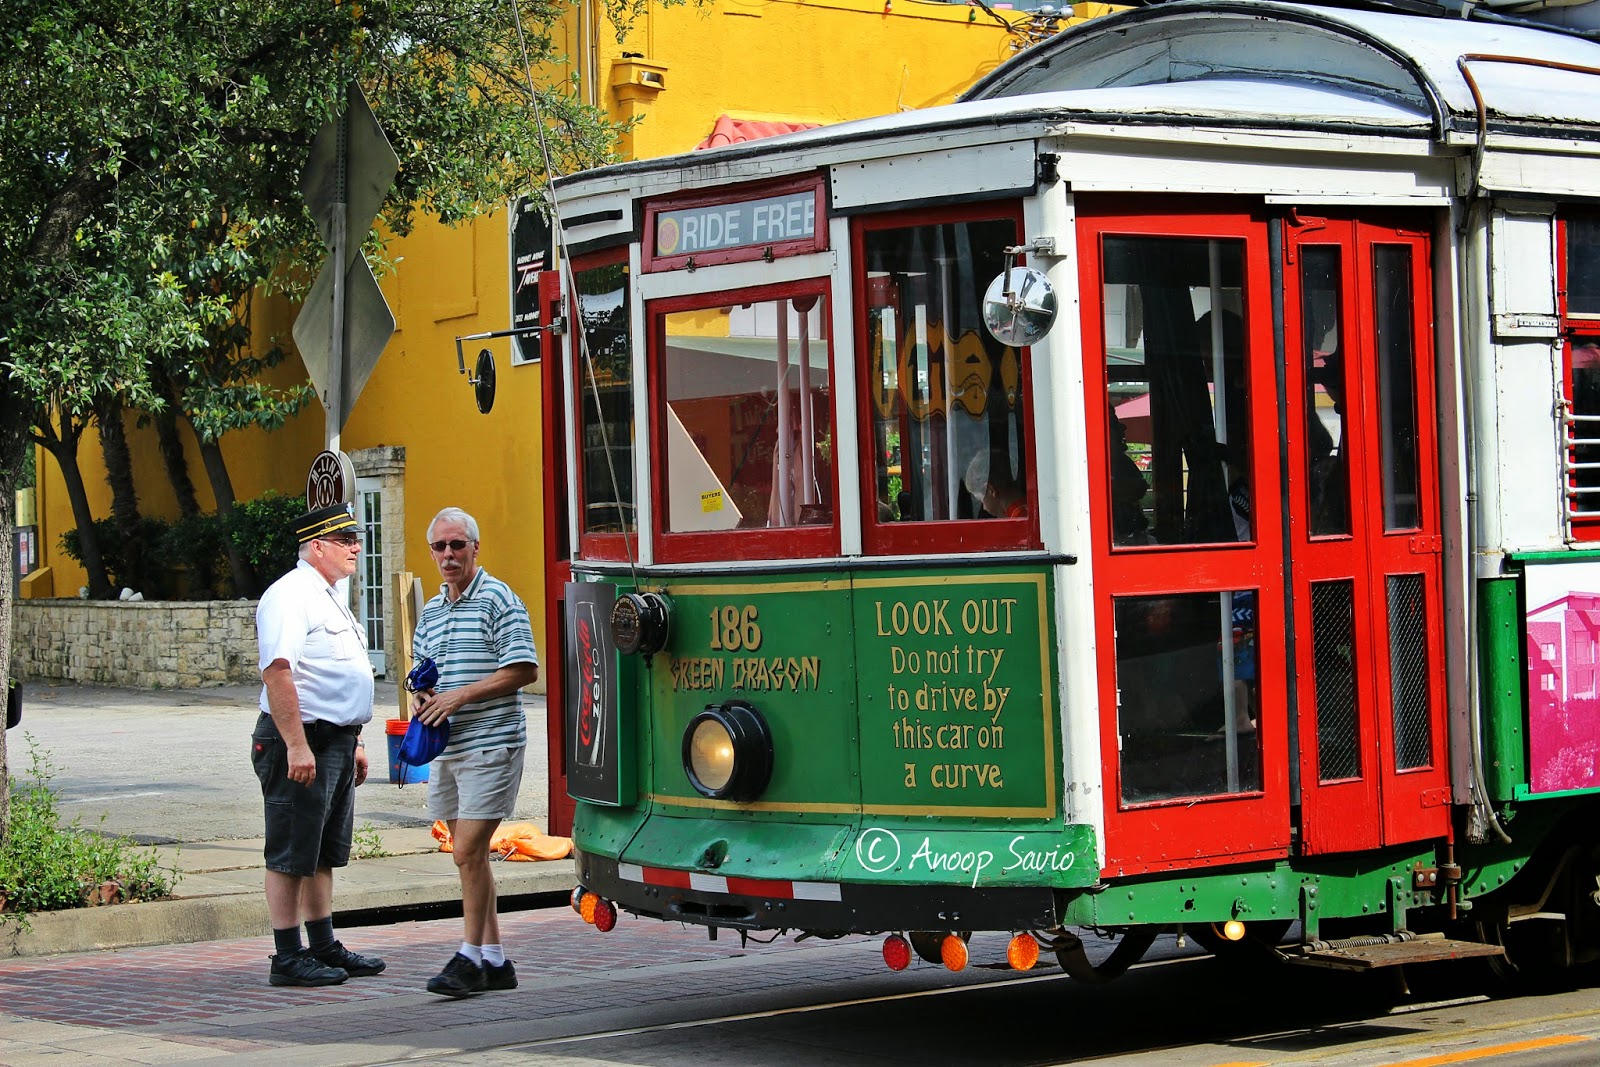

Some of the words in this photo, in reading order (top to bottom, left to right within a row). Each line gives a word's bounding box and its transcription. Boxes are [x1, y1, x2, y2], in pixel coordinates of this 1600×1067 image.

[682, 209, 741, 251] RIDE
[752, 199, 815, 241] FREE
[709, 605, 762, 651] 186
[875, 599, 953, 636] LOOK
[961, 598, 1017, 635] OUT
[592, 648, 600, 718] zero
[670, 657, 724, 691] GREEN
[731, 656, 819, 691] DRAGON
[891, 646, 921, 675] Do
[926, 644, 960, 674] not
[967, 644, 1005, 684] try
[888, 684, 909, 711] to
[915, 681, 977, 711] drive
[983, 680, 1011, 724] by
[892, 716, 933, 748] this
[936, 724, 974, 749] car
[978, 724, 1004, 748] on
[903, 762, 917, 788] a
[930, 763, 1003, 788] curve
